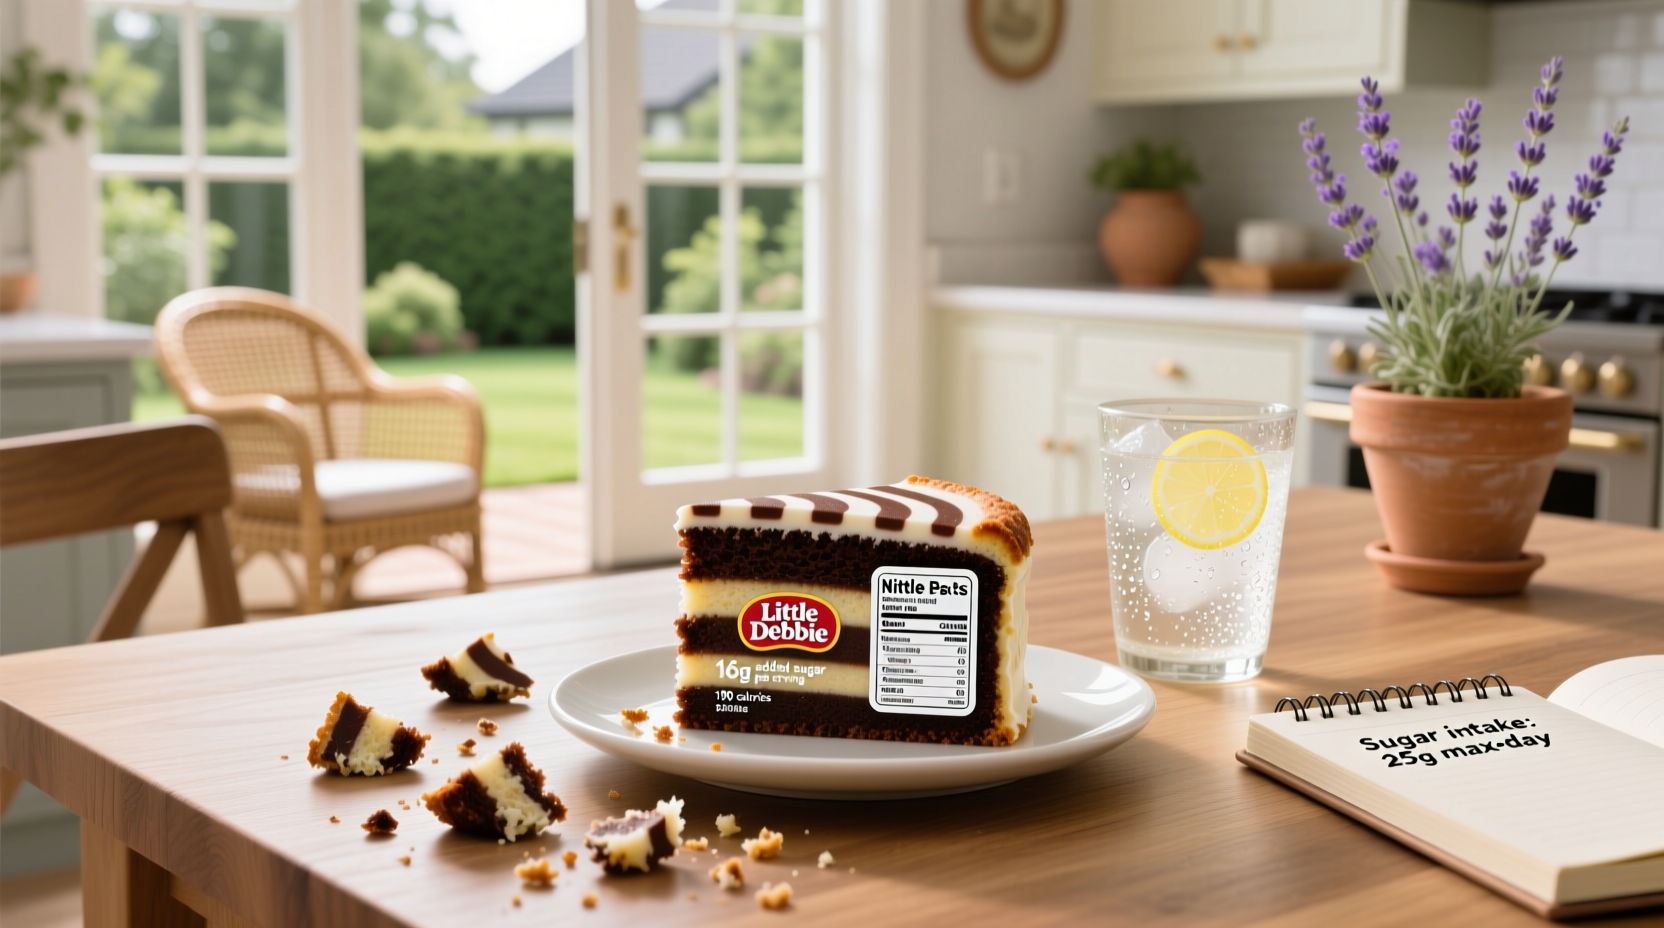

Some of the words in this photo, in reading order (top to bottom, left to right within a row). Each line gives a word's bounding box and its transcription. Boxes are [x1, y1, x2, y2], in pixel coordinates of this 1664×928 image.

[882, 578, 925, 595] Nittle
[761, 601, 819, 622] Little
[749, 620, 829, 643] Debbie
[715, 659, 752, 684] 16g
[1359, 731, 1438, 751] Sugar
[1443, 718, 1537, 739] intake:
[1381, 750, 1438, 768] 25g
